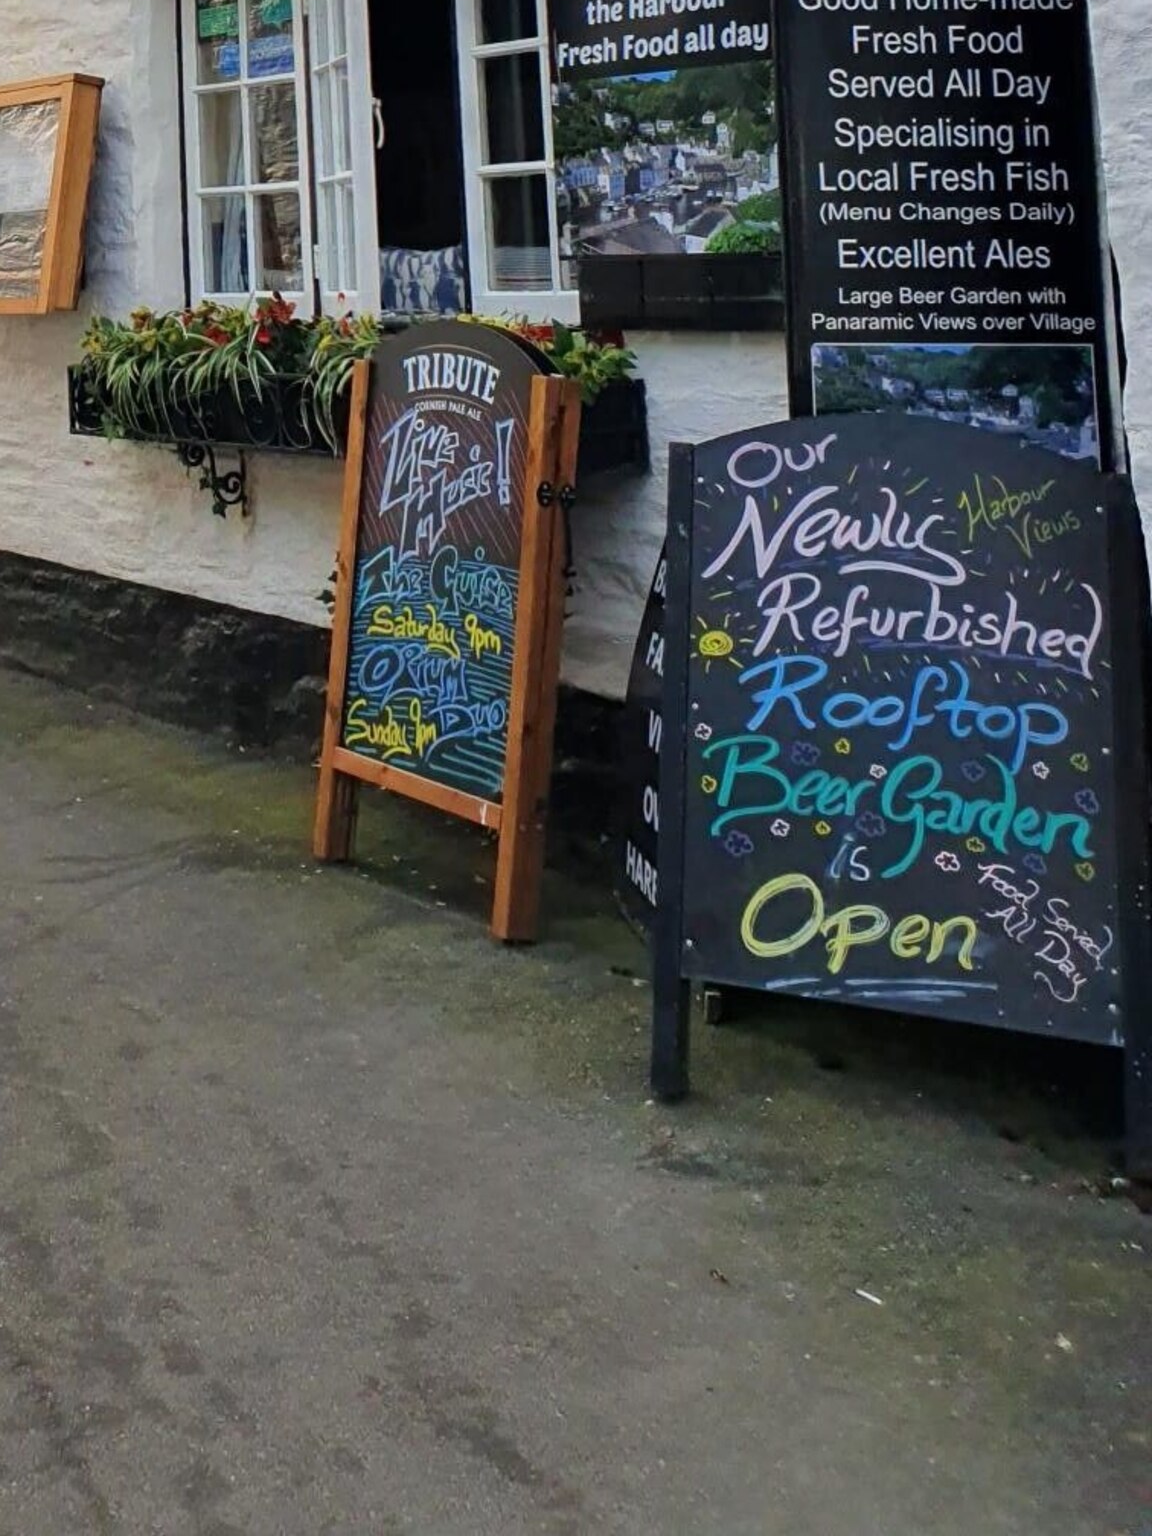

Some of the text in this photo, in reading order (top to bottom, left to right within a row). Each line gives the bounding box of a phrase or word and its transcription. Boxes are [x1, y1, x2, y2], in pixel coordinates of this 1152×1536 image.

[557, 20, 770, 68] Fresh Food all day
[852, 25, 1024, 55] Fresh Food
[828, 68, 1052, 105] Served All Day
[834, 117, 1050, 155] Specialising in
[818, 162, 1069, 192] Local Fresh Fish
[819, 202, 1076, 225] (Menu Changes Daily)
[837, 238, 1052, 269] Excellent Ales
[838, 286, 1067, 309] Large Beer Garden with
[811, 312, 1097, 335] Panaramic Views over Village
[403, 352, 501, 405] TRIBUTE
[414, 399, 482, 422] CORNISH PALE ALE
[727, 433, 839, 489] Our
[356, 544, 424, 615] The
[366, 604, 502, 660] Saturday 9pm
[752, 571, 1103, 681] Refurbished
[345, 698, 438, 760] Sunday 9pm
[739, 651, 1071, 777] Rooftop
[702, 734, 1096, 879] Beer Garden
[827, 832, 871, 882] is
[977, 863, 1040, 912] Food
[741, 872, 978, 975] Open
[984, 905, 1037, 944] All
